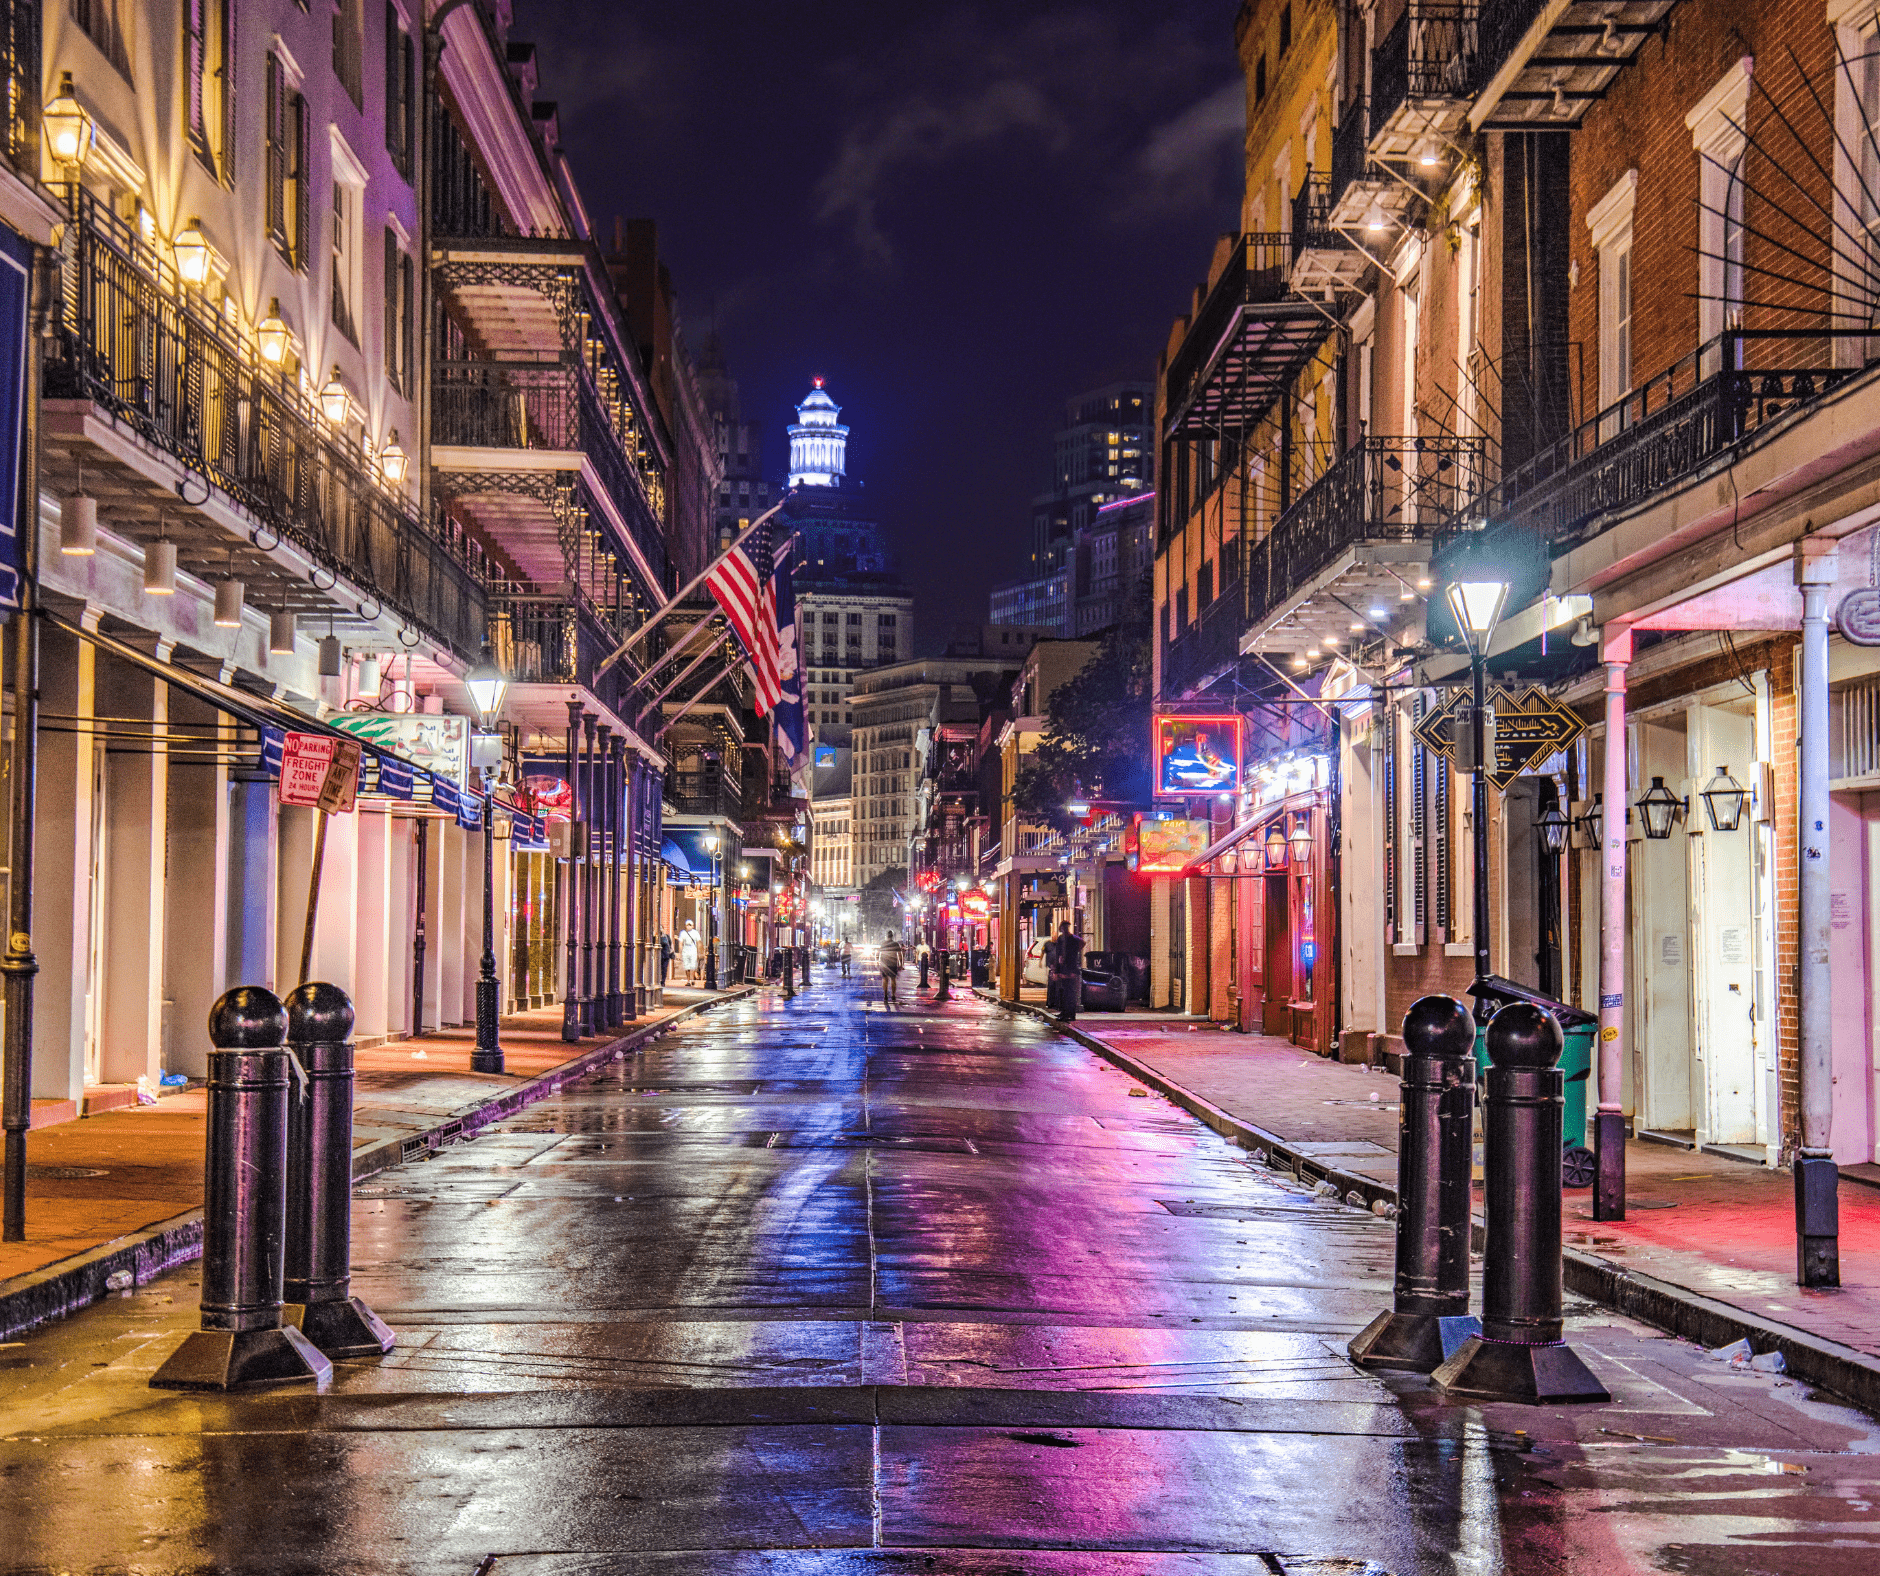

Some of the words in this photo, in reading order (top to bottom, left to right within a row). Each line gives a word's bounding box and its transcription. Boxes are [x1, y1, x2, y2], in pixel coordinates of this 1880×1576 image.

[285, 737, 299, 752] NO
[299, 742, 331, 754] PARKING
[286, 758, 326, 771] FREIGHT
[292, 769, 318, 782] ZONE
[299, 783, 319, 792] HOURS
